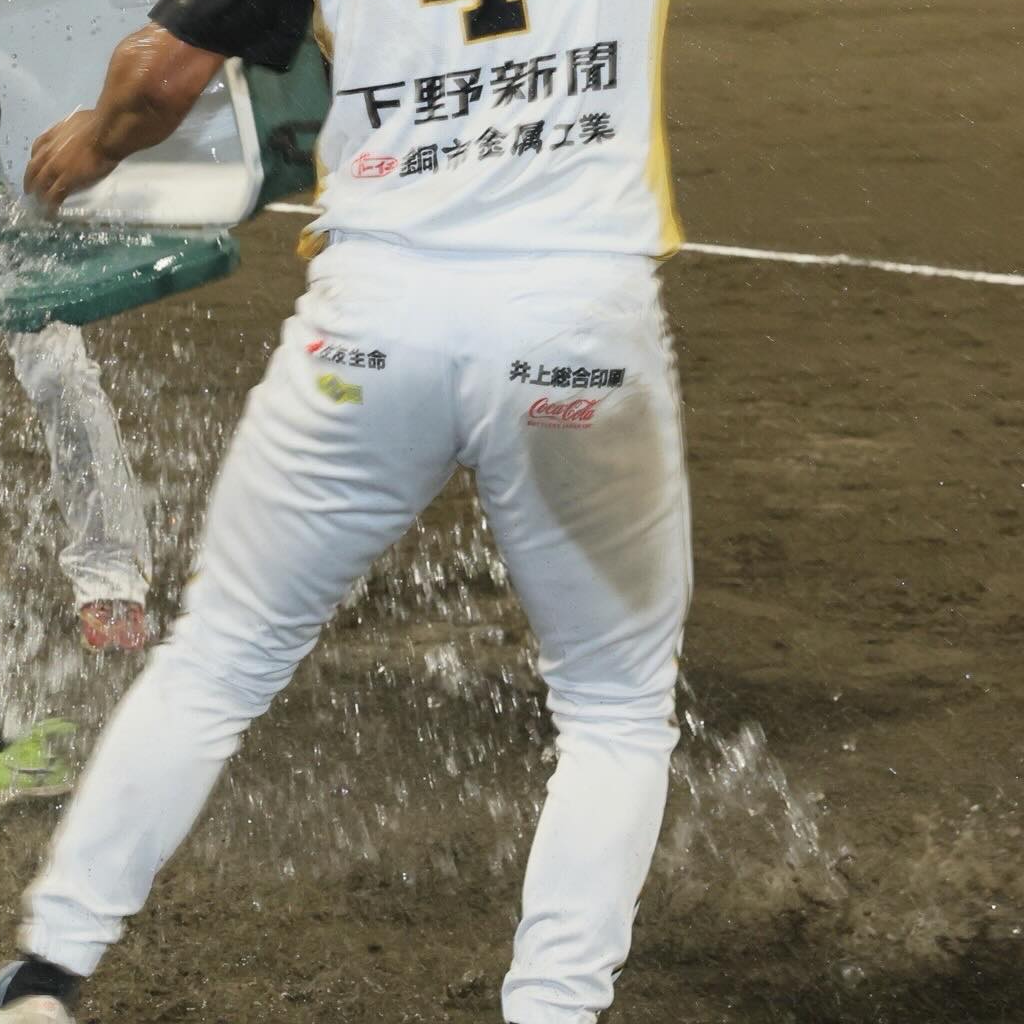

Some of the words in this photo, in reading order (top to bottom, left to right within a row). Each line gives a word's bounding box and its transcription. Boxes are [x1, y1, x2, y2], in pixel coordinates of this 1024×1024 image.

[336, 40, 619, 129] 下野新聞
[399, 112, 617, 177] 銅市金属工業
[509, 360, 626, 389] 井上総合印刷
